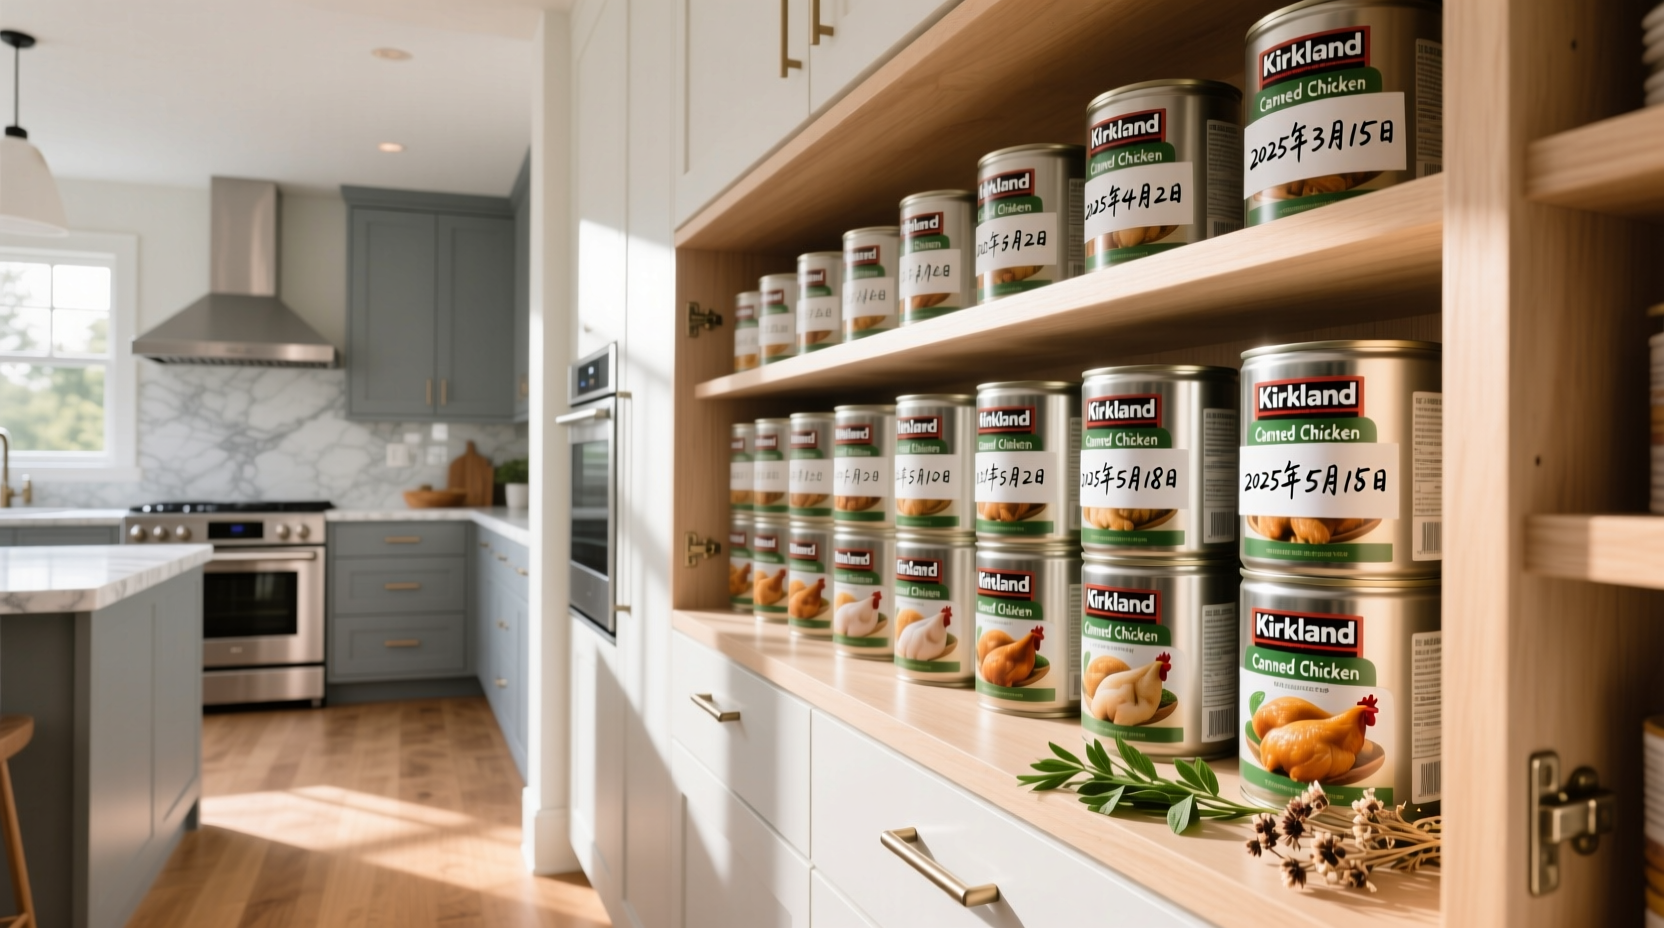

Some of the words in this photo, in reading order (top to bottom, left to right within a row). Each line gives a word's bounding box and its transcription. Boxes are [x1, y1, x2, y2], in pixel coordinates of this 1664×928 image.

[1263, 32, 1362, 77] Kirkland
[1307, 75, 1366, 97] Chicken
[1091, 113, 1160, 149] Kirkland
[1118, 149, 1162, 166] Chicken
[1249, 119, 1394, 171] 2025年3月15日
[977, 229, 1047, 259] 年5月2日
[1259, 382, 1356, 409] Kirkland
[1088, 398, 1155, 421] Kirkland
[1115, 433, 1158, 447] Chicken
[1300, 424, 1360, 441] Chicken
[976, 463, 1045, 493] 年5月2日
[1244, 460, 1387, 500] 2025年5月15日
[1086, 588, 1155, 614] Kirkland
[1114, 625, 1158, 643] Chicken
[1256, 612, 1355, 645] Kirkland
[1252, 653, 1296, 675] Canned
[1299, 660, 1360, 681] Chicken
